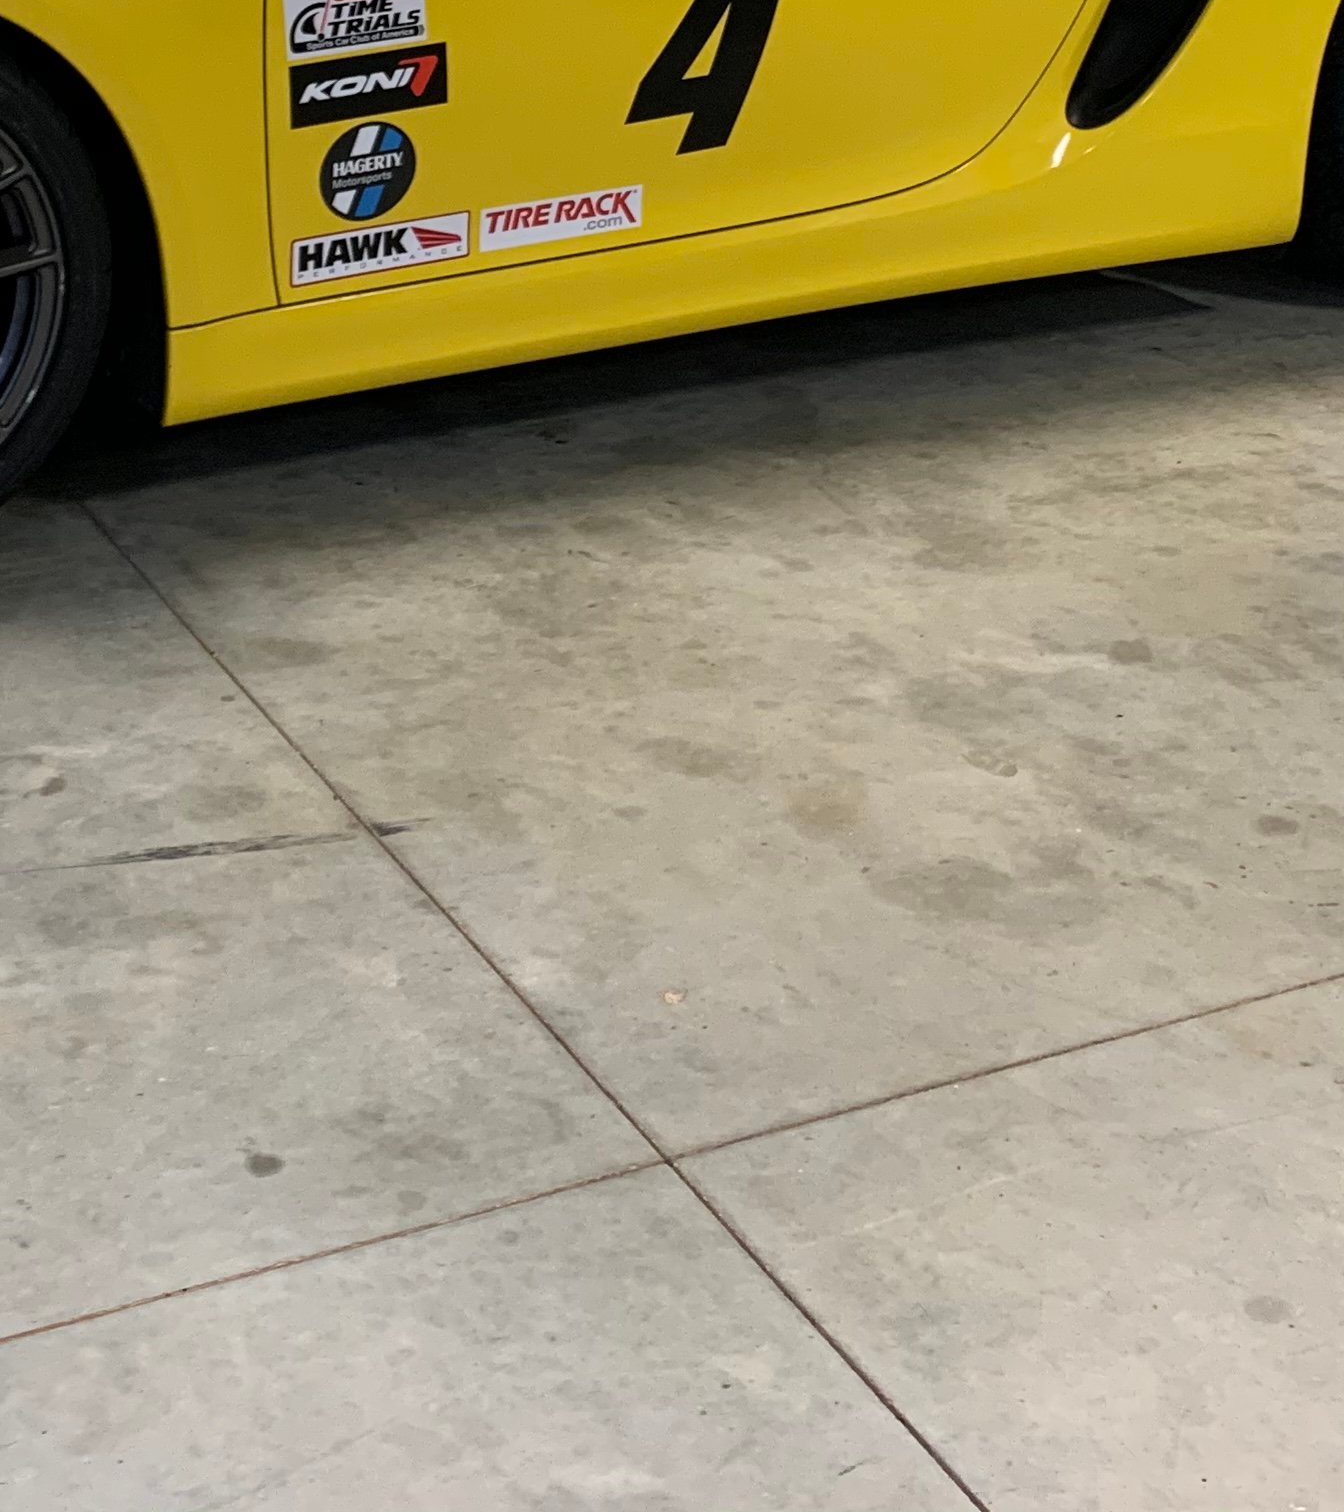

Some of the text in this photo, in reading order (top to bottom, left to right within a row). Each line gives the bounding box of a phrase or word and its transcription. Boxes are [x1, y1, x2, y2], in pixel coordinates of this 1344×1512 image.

[306, 40, 334, 51] Sports
[335, 38, 349, 46] Car
[299, 67, 416, 105] KONI
[332, 151, 404, 178] HAGERTY
[332, 172, 393, 189] Motorsports
[486, 190, 637, 234] TIRE RACK
[584, 216, 623, 231] .com
[298, 227, 408, 272] HAWK
